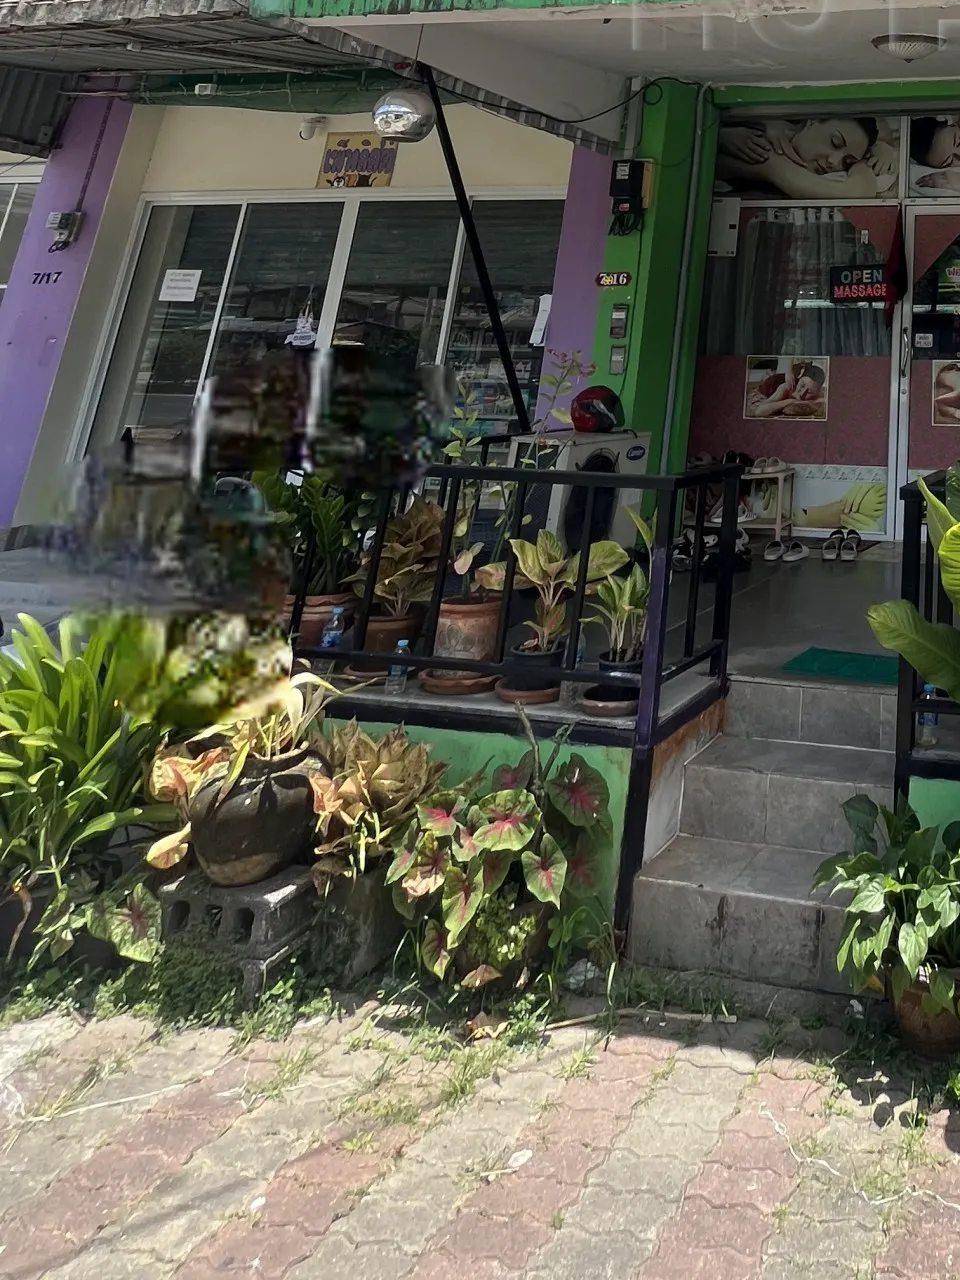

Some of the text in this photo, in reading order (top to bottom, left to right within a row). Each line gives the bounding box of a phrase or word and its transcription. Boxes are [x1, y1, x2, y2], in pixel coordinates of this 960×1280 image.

[32, 271, 63, 284] 7/17
[840, 269, 883, 283] OPEN
[833, 283, 887, 298] MASSAGE
